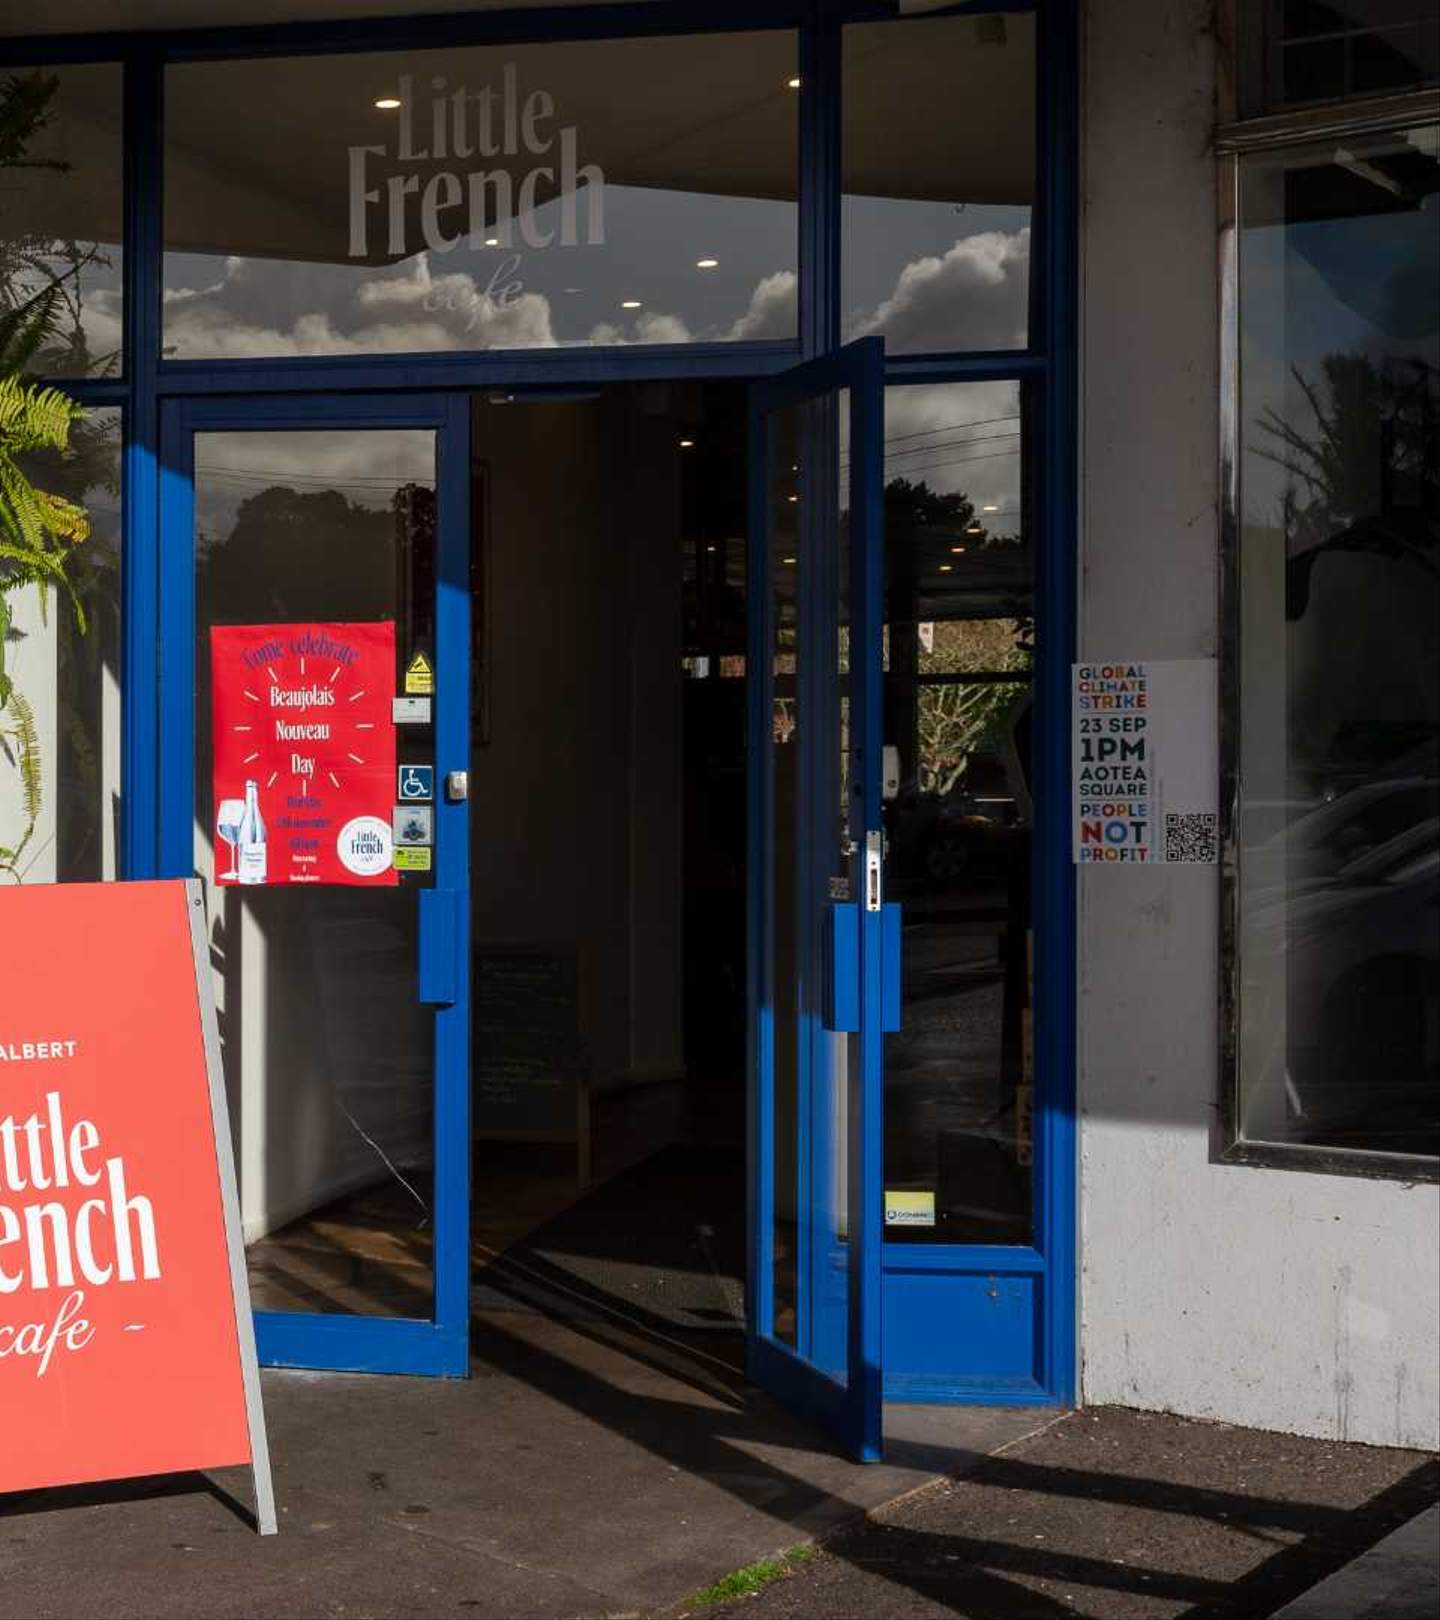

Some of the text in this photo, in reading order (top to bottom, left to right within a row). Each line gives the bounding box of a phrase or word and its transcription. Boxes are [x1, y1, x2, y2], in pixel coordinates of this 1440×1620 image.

[397, 62, 555, 161] Little
[347, 125, 606, 258] French
[1079, 666, 1147, 680] GLOBAL
[1079, 680, 1147, 693] CLIMATE
[270, 685, 335, 711] Beaujolais
[1079, 694, 1147, 709] STRIKE
[275, 719, 330, 741] Nouveau
[1080, 717, 1146, 733] 23 SEP
[1080, 737, 1146, 762] 1PM
[291, 753, 316, 779] Day
[1080, 765, 1147, 781] AOTEA
[1079, 783, 1147, 796] SQUARE
[1080, 803, 1147, 818] PEOPLE
[1080, 820, 1147, 844] NOT
[351, 839, 383, 855] French
[1080, 847, 1148, 862] PROFIT
